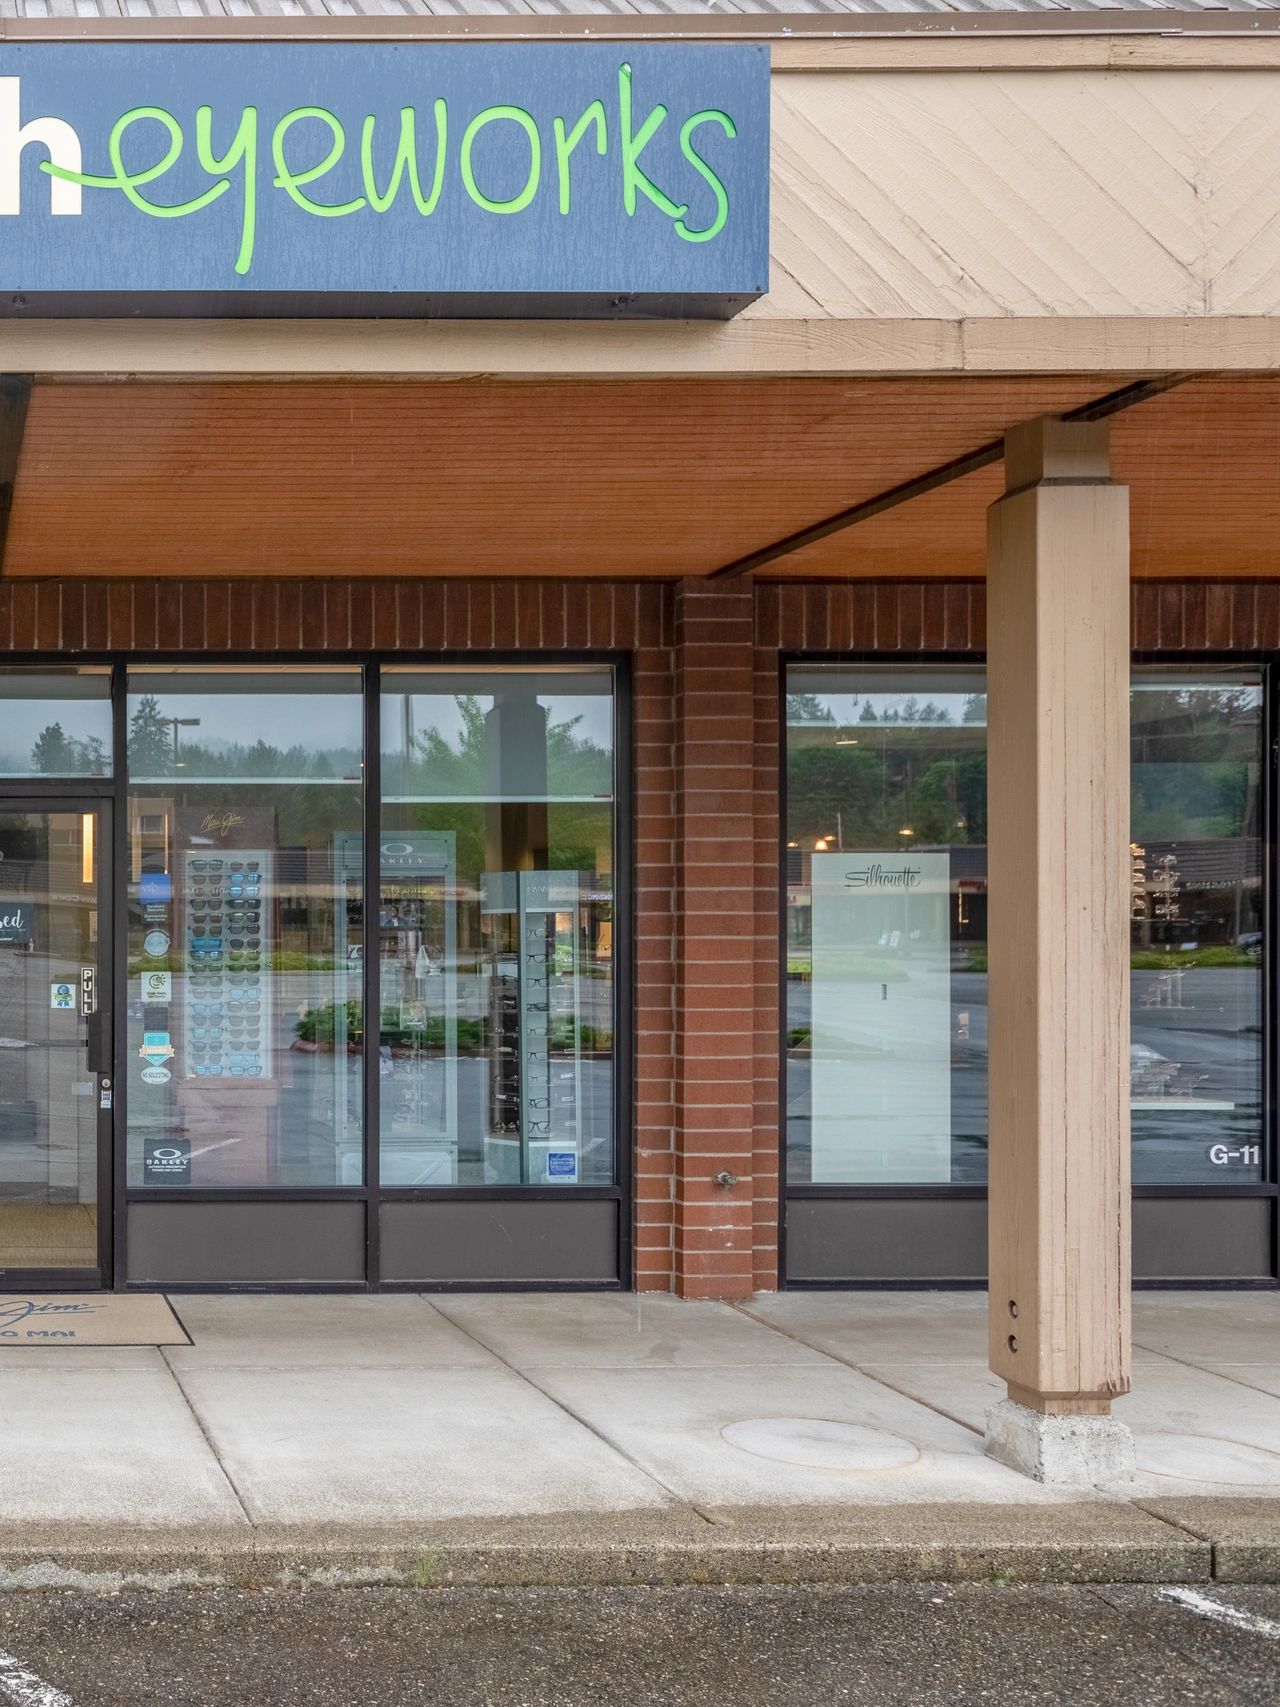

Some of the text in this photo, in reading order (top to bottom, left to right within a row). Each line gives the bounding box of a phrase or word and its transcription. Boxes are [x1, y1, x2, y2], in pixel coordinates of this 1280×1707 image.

[39, 62, 737, 275] eyeworks
[844, 864, 921, 888] Silhouette
[83, 970, 92, 1014] PULL
[1210, 1144, 1259, 1165] G-11
